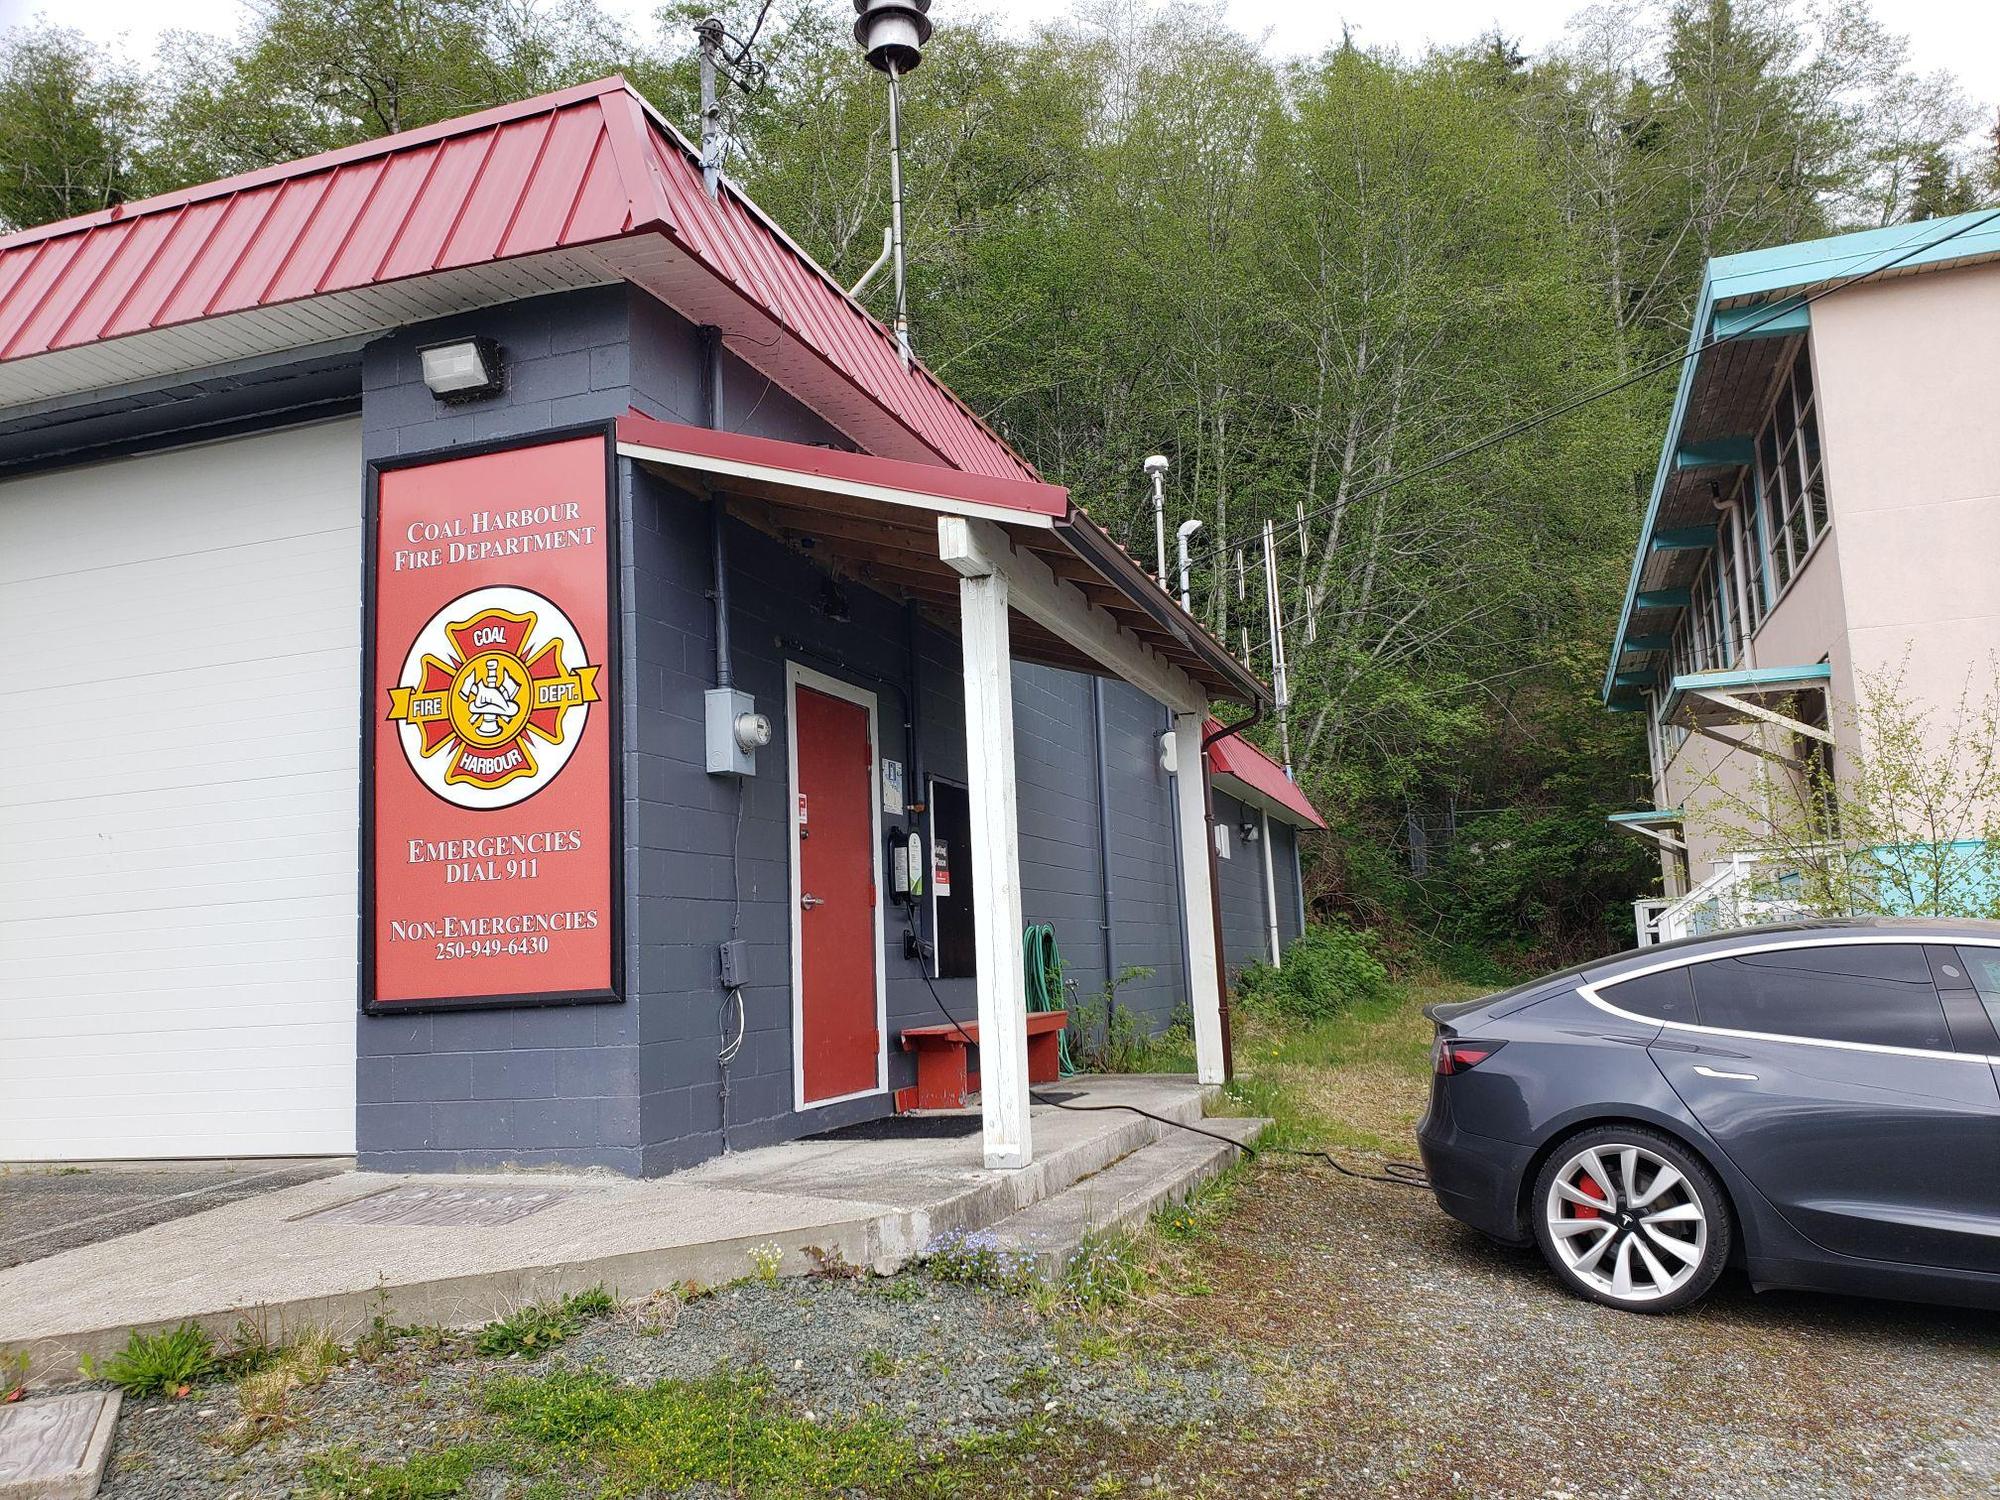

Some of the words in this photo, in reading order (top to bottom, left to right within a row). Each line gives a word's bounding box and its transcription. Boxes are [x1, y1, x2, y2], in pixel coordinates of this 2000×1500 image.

[473, 626, 507, 647] COAL
[539, 683, 579, 703] DEPT.
[413, 697, 442, 717] FIRE
[460, 748, 523, 775] HARBOUR
[446, 861, 501, 884] DIAL
[506, 858, 539, 880] 911
[436, 936, 549, 961] 250-949-6430
